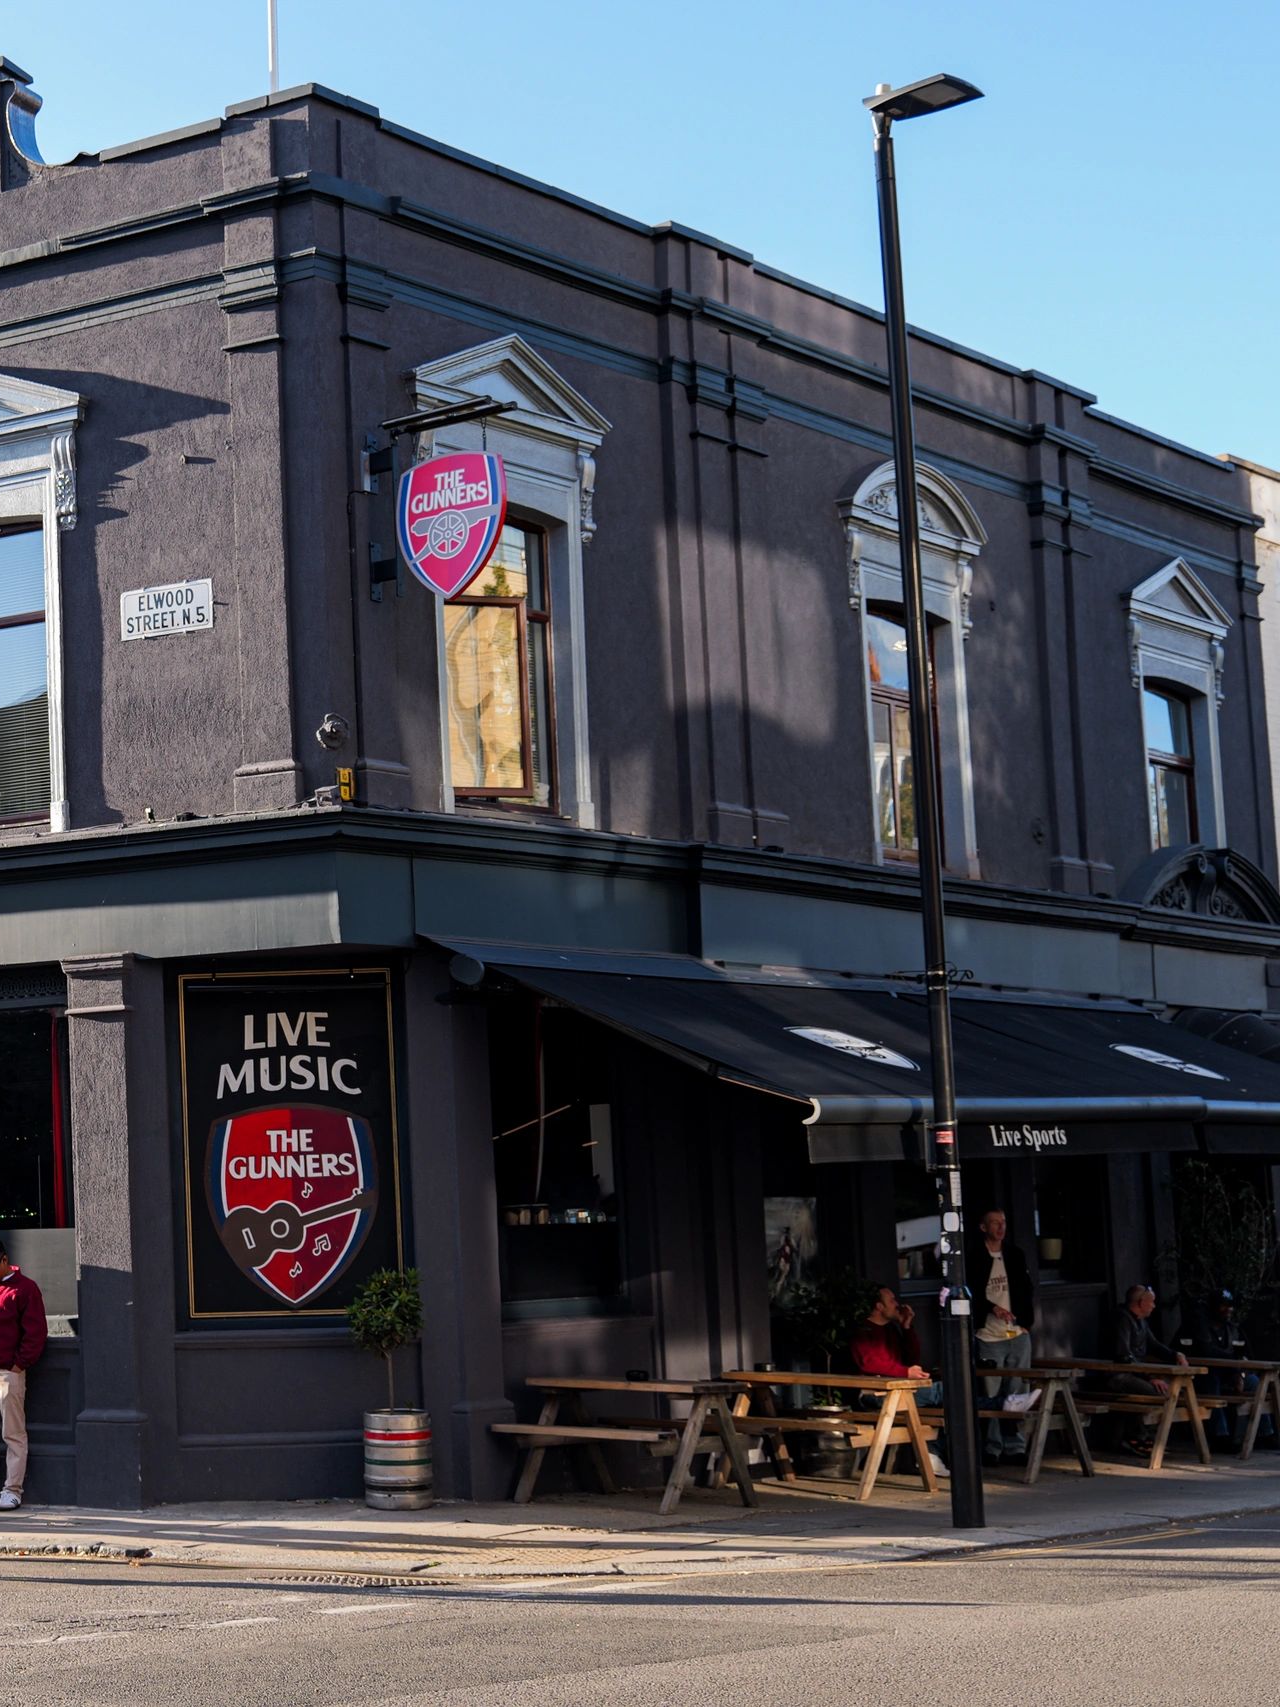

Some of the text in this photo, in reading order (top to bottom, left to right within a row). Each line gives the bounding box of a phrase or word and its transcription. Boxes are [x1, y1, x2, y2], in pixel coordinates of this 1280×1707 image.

[434, 468, 465, 491] THE
[411, 480, 488, 514] GUNNERS
[138, 588, 194, 612] ELWOOD
[126, 610, 180, 633] STREET.
[244, 1011, 331, 1051] LIVE
[216, 1054, 363, 1100] MUSIC
[266, 1129, 314, 1153] THE
[988, 1124, 1068, 1151] Live Sports
[228, 1153, 356, 1179] GUNNERS
